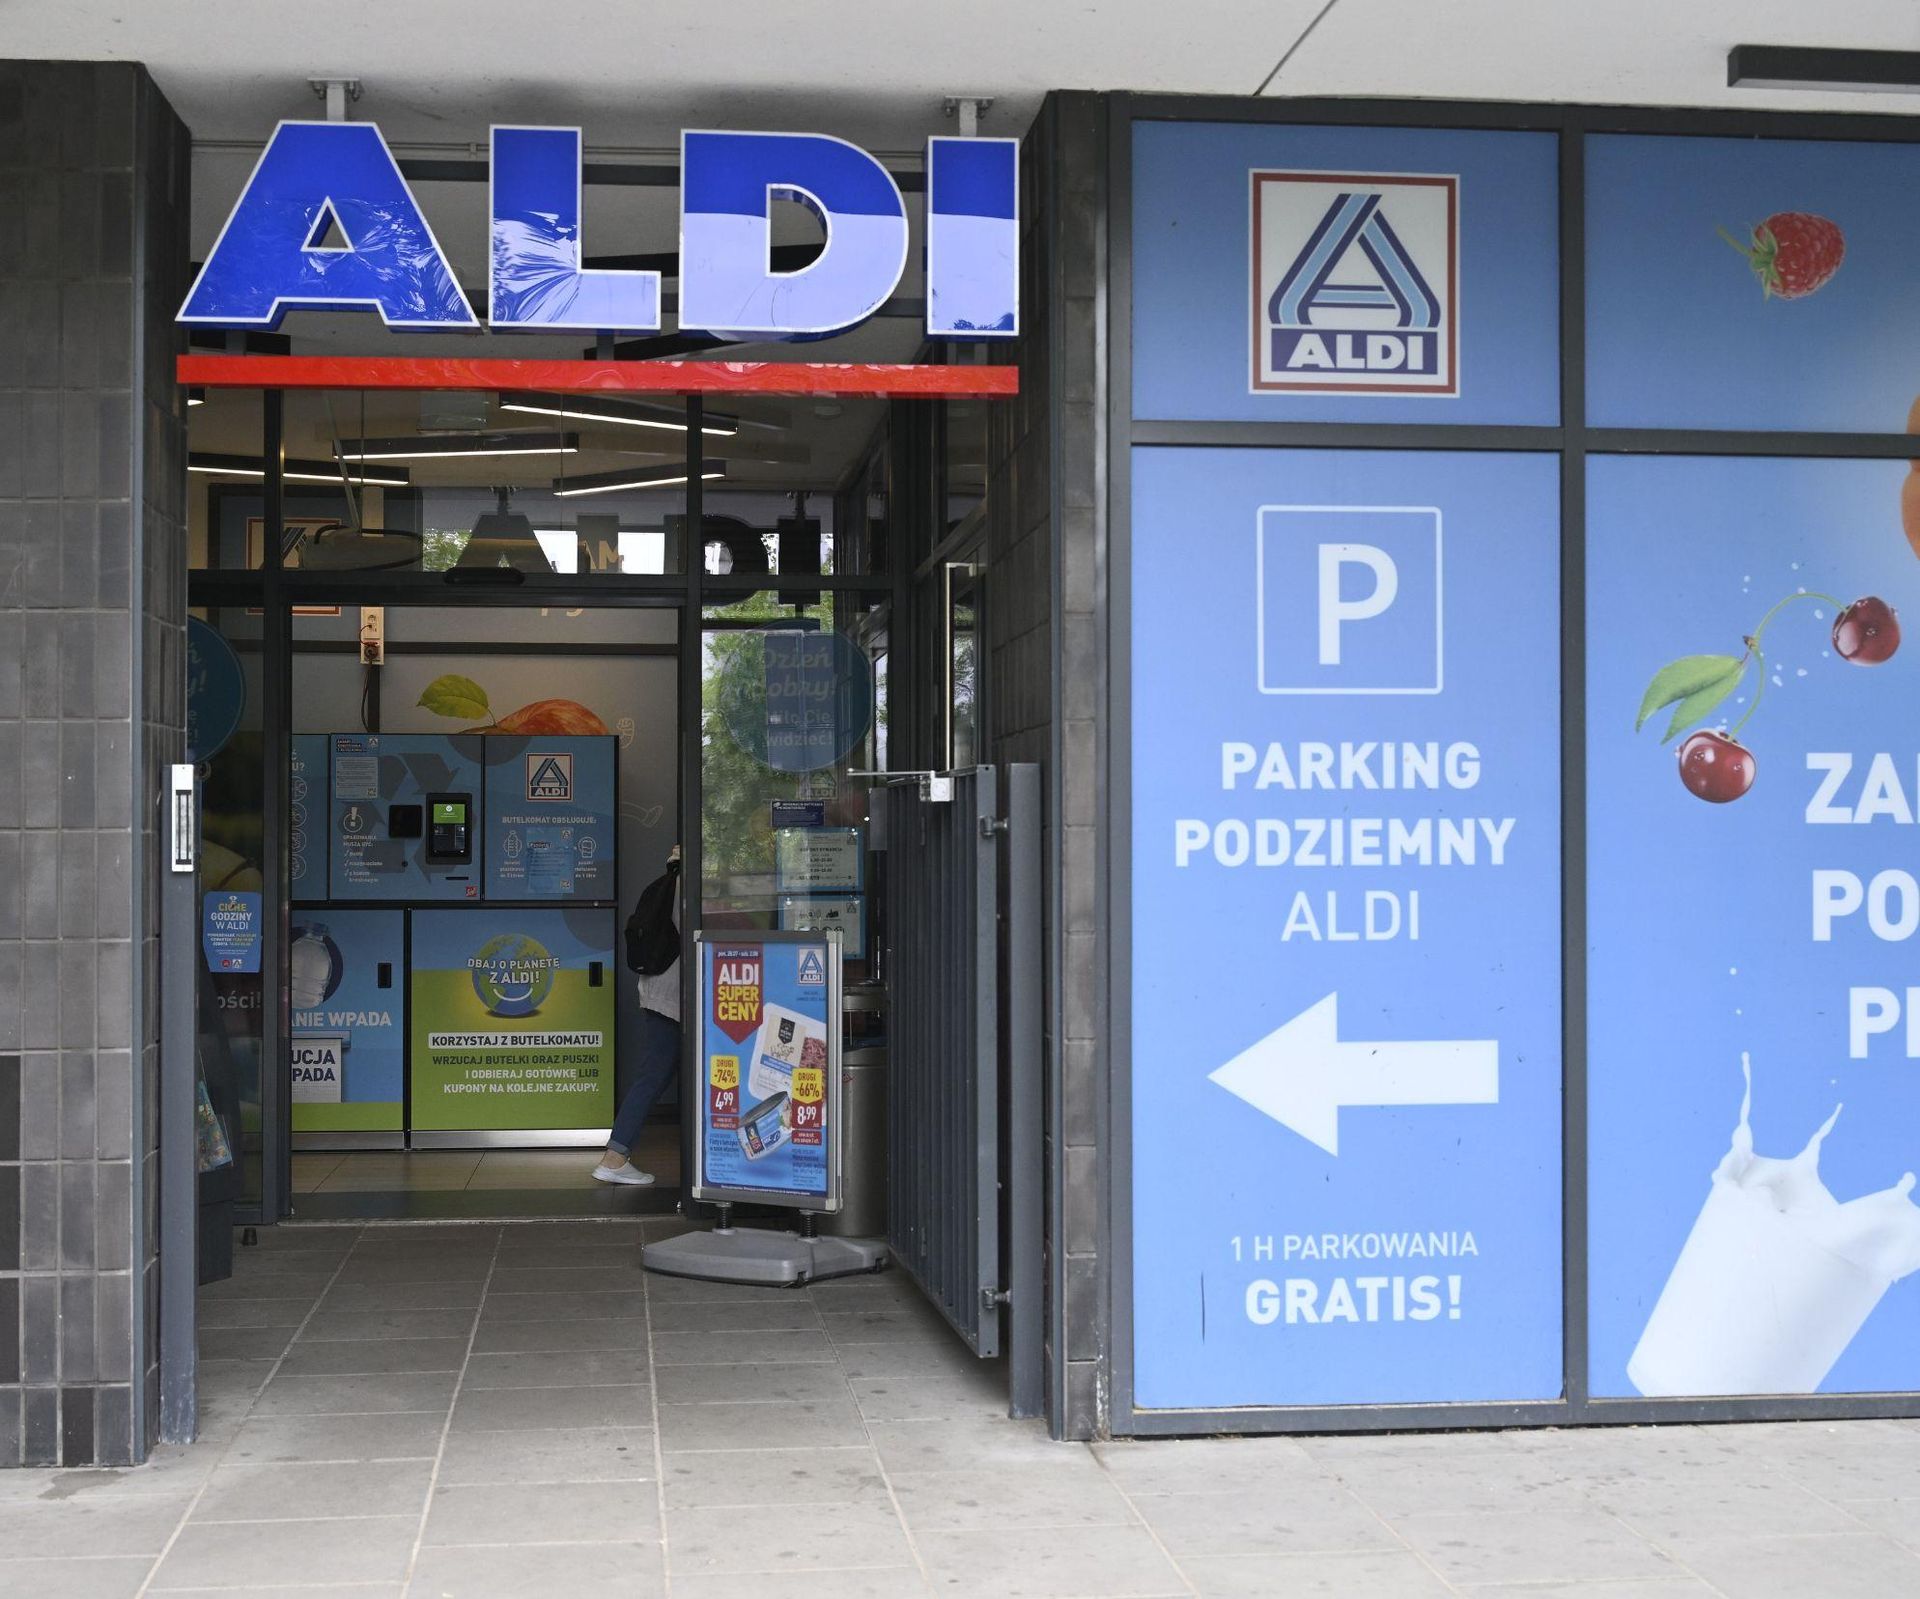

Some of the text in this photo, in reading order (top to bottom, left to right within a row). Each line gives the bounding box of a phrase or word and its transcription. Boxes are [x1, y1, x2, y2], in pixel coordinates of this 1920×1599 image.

[175, 119, 1021, 340] ALDI
[1287, 333, 1425, 371] ALDI
[1318, 543, 1398, 665] P
[1221, 741, 1481, 790] PARKING
[534, 787, 565, 797] ALDI
[1805, 752, 1920, 824] ZA
[1175, 817, 1516, 868] PODZIEMNY
[210, 912, 252, 922] GODZINY
[1281, 890, 1421, 942] ALDI
[216, 921, 249, 931] W ALDI
[467, 956, 560, 971] DBAJ O PLANETĘ
[489, 970, 541, 984] Z ALDI!
[718, 963, 759, 985] ALDI
[801, 974, 821, 982] ALDI
[718, 986, 759, 1002] SUPER
[328, 1010, 392, 1027] WPADA
[718, 1002, 760, 1021] CENY
[431, 1034, 600, 1047] KORZYSTAJ Z BUTELKOMATU!
[432, 1053, 600, 1066] WRZUCAJ BUTELKI ORAZ PUSZKI
[716, 1059, 734, 1068] DRUGI
[470, 1069, 524, 1080] ODBIERAJ
[525, 1067, 577, 1082] GOTÓWKĘ
[578, 1068, 600, 1079] LUB
[714, 1069, 736, 1084] -74%
[798, 1072, 816, 1082] DRUGI
[443, 1082, 599, 1094] KUPONY NA KOLEJNE ZAKUPY.
[796, 1085, 819, 1098] -66%
[1231, 1231, 1479, 1261] 1 H PARKOWANIA
[1245, 1275, 1463, 1325] GRATIS!
